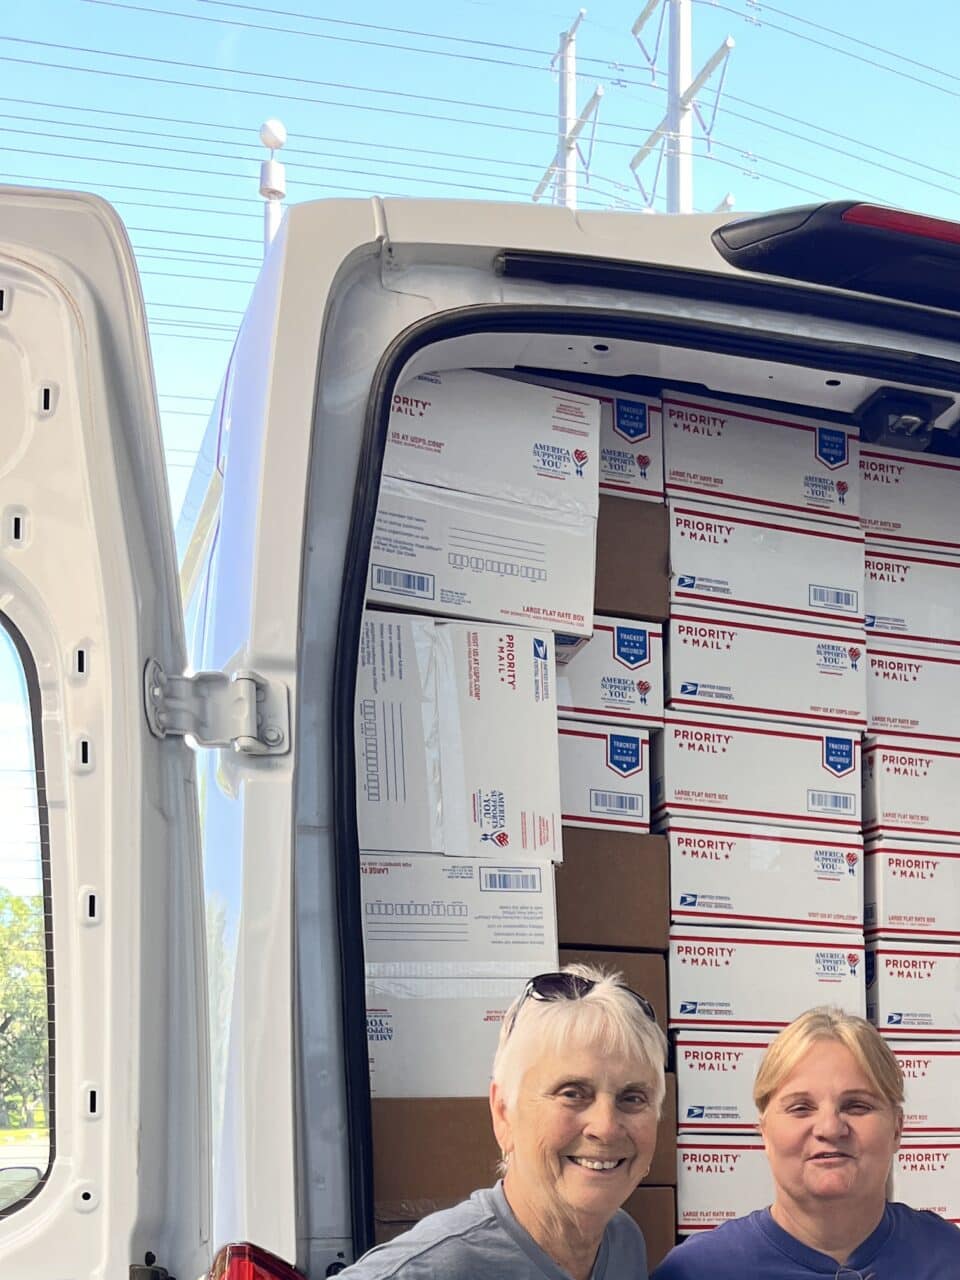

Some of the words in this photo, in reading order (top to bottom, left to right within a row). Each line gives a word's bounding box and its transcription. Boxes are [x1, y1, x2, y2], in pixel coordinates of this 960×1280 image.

[394, 395, 428, 409] ORITY
[669, 409, 725, 428] PRIORITY
[683, 424, 713, 436] MAIL
[534, 443, 570, 456] AMERICA
[601, 449, 634, 459] AMERICA
[533, 451, 571, 463] SUPPORTS
[601, 455, 635, 466] SUPPORTS
[542, 460, 561, 470] YOU
[609, 463, 627, 472] YOU
[859, 460, 902, 475] RIORITY
[864, 473, 890, 483] MAIL
[676, 518, 732, 535] PRIORITY
[690, 532, 719, 544] MAIL
[865, 560, 908, 574] RIORITY
[870, 572, 897, 583] MAIL
[523, 606, 540, 615] LARGE
[543, 608, 556, 617] FLAT
[558, 611, 571, 619] RATE
[621, 633, 644, 641] TRACKED
[678, 625, 735, 641] PRIORITY
[692, 639, 722, 650] MAIL
[817, 644, 846, 652] AMERICA
[621, 647, 644, 655] INSURED
[816, 650, 847, 659] SUPPORTS
[823, 657, 840, 665] YOU
[871, 659, 920, 673] PRIORITY
[602, 677, 634, 686] AMERICA
[883, 672, 909, 682] MAIL
[601, 683, 635, 692] SUPPORTS
[608, 690, 626, 699] YOU
[674, 730, 731, 744] PRIORITY
[614, 741, 636, 749] TRACKED
[688, 742, 717, 753] MAIL
[614, 755, 636, 763] INSURED
[883, 755, 932, 768] PRIORITY
[894, 767, 920, 777] MAIL
[677, 837, 734, 851] PRIORITY
[691, 850, 720, 860] MAIL
[814, 850, 844, 858] AMERICA
[821, 862, 838, 870] YOU
[888, 858, 937, 870] PRIORITY
[900, 870, 926, 879] MAIL
[677, 946, 734, 956] PRIORITY
[691, 958, 720, 967] MAIL
[886, 960, 935, 969] PRIORITY
[898, 971, 923, 979] MAIL
[684, 1051, 741, 1060] PRIORITY
[699, 1063, 727, 1071] MAIL
[682, 1154, 739, 1163] PRIORITY
[899, 1153, 948, 1162] PRIORITY
[696, 1165, 725, 1173] MAIL
